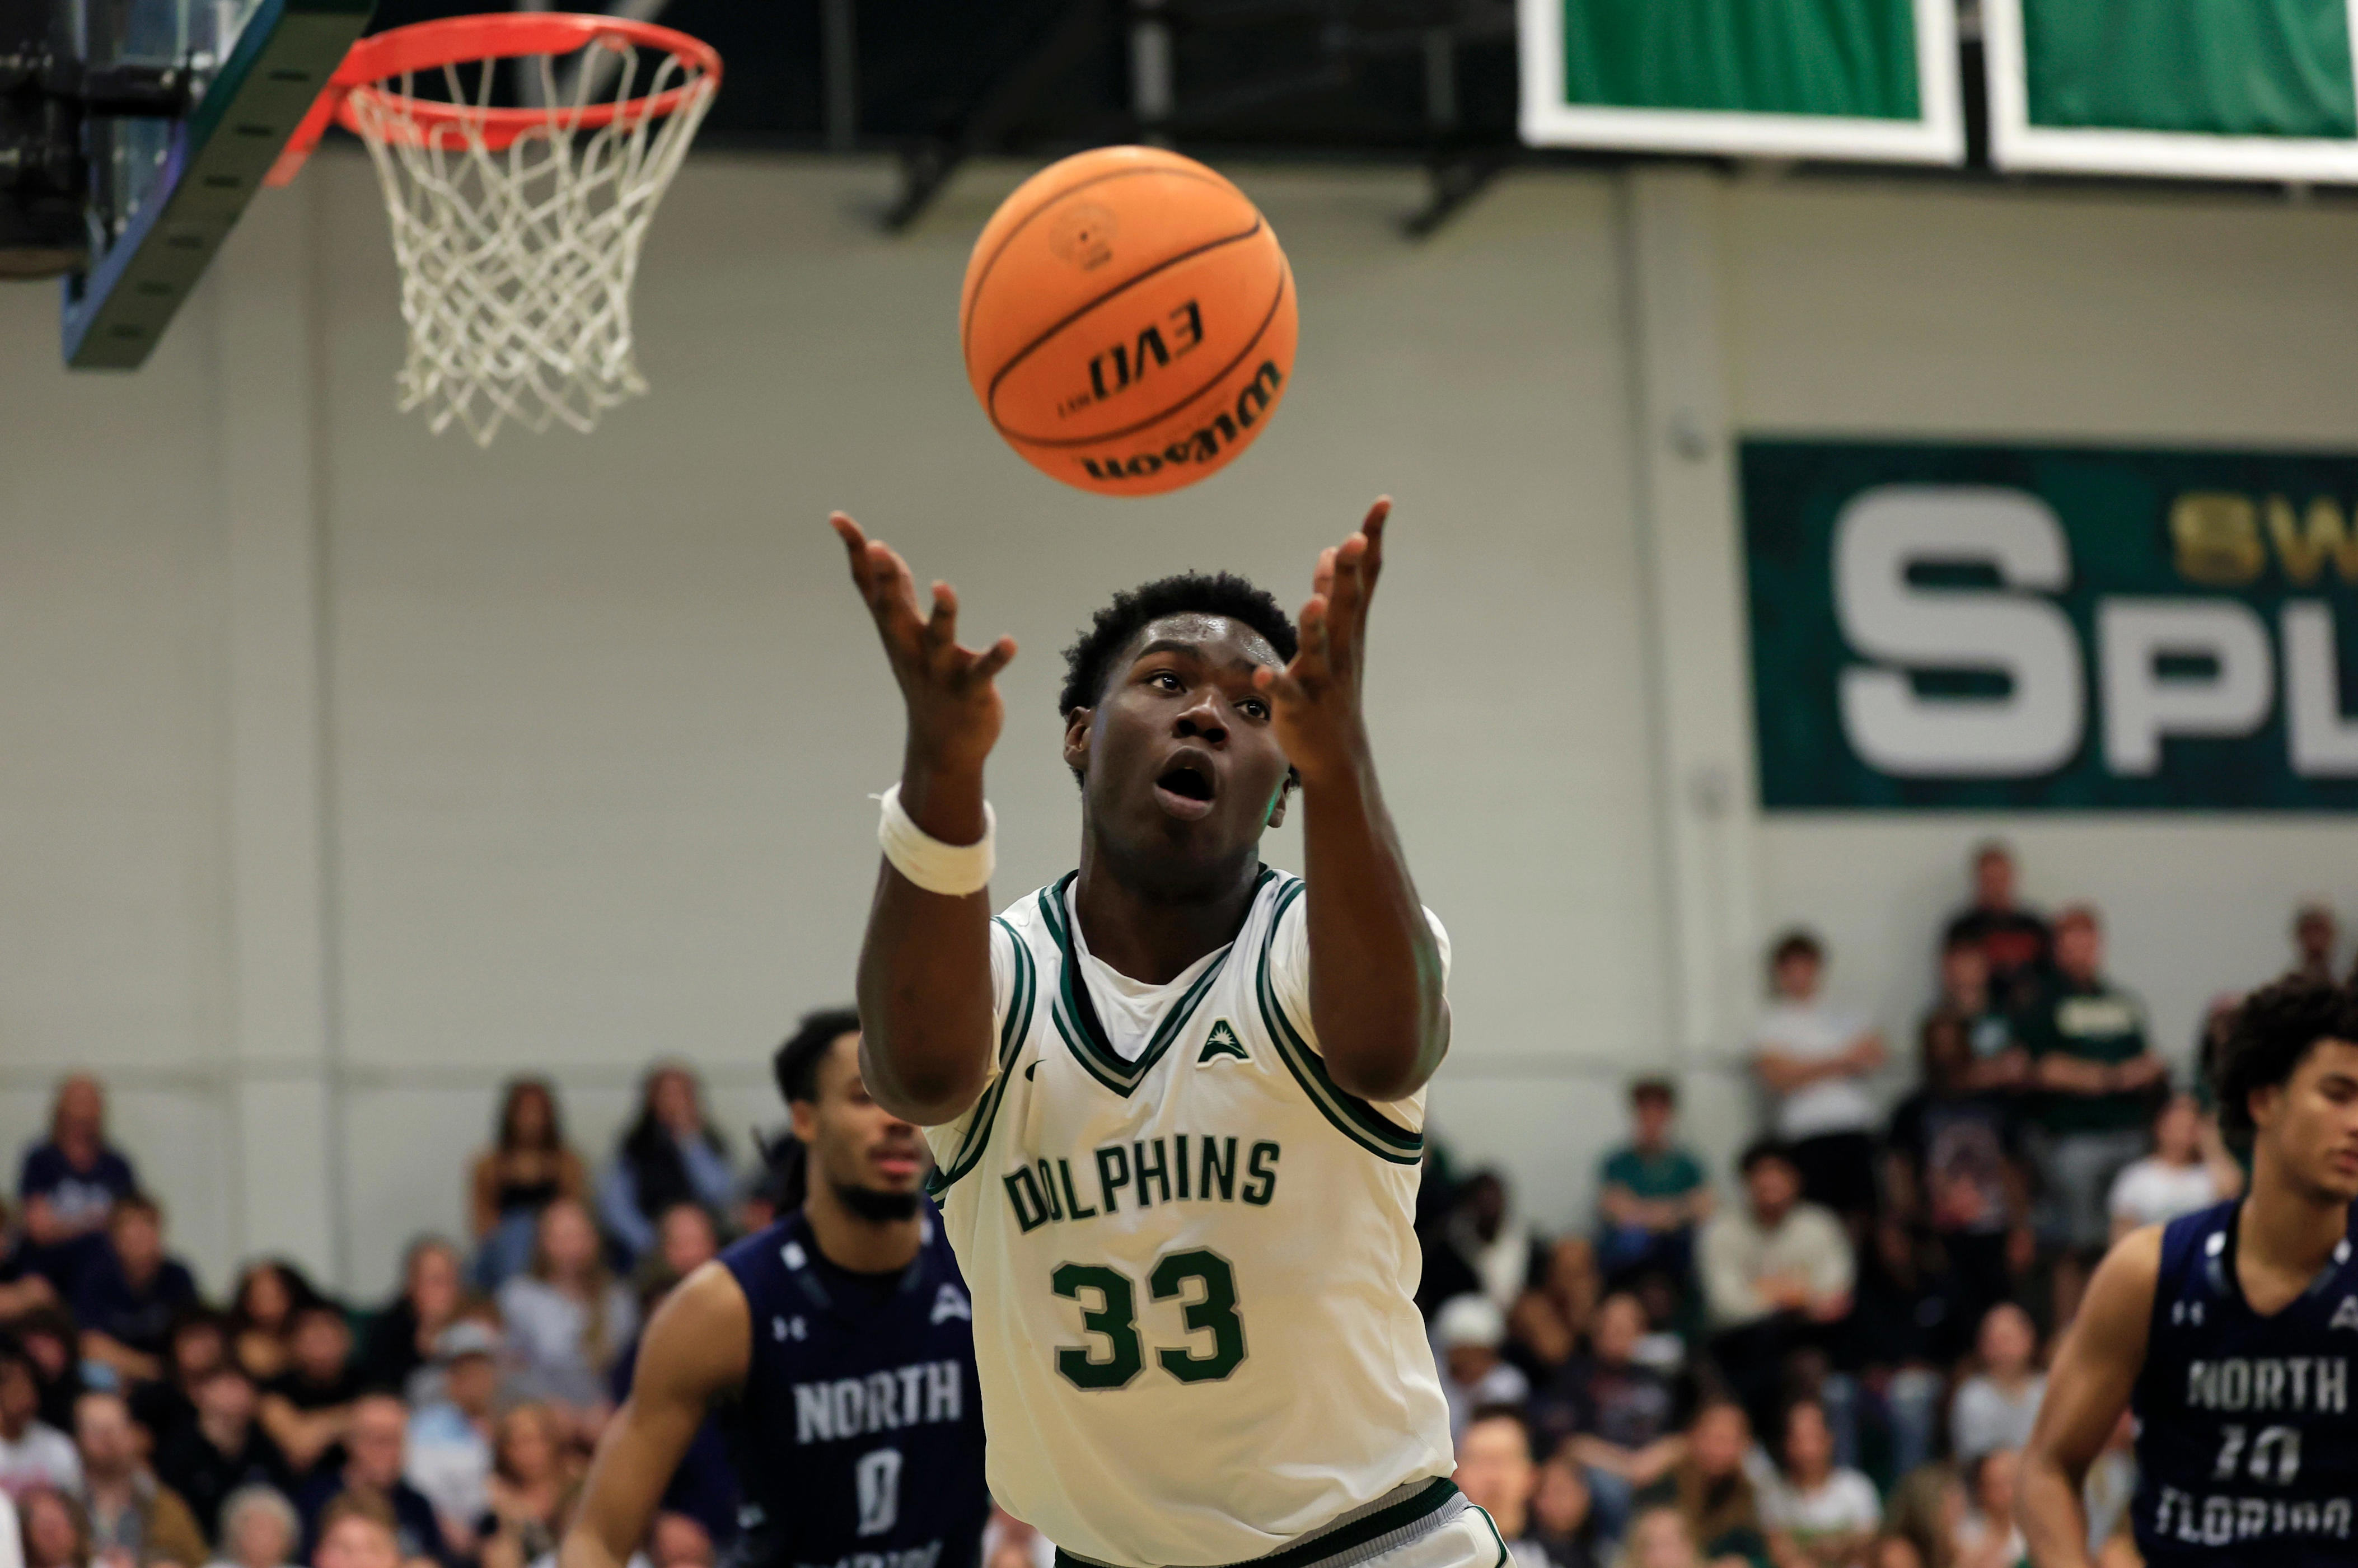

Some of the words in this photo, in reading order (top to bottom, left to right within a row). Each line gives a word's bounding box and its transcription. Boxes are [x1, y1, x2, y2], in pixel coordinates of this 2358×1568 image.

[1088, 298, 1204, 401] EVO
[1830, 481, 2358, 778] SPL
[1002, 1133, 1280, 1235] DOLPHINS
[1050, 1245, 1249, 1392] 33
[793, 1358, 963, 1445] NORTH
[2186, 1356, 2348, 1415] NORTH
[855, 1445, 904, 1538] 0
[2211, 1423, 2302, 1487] 10
